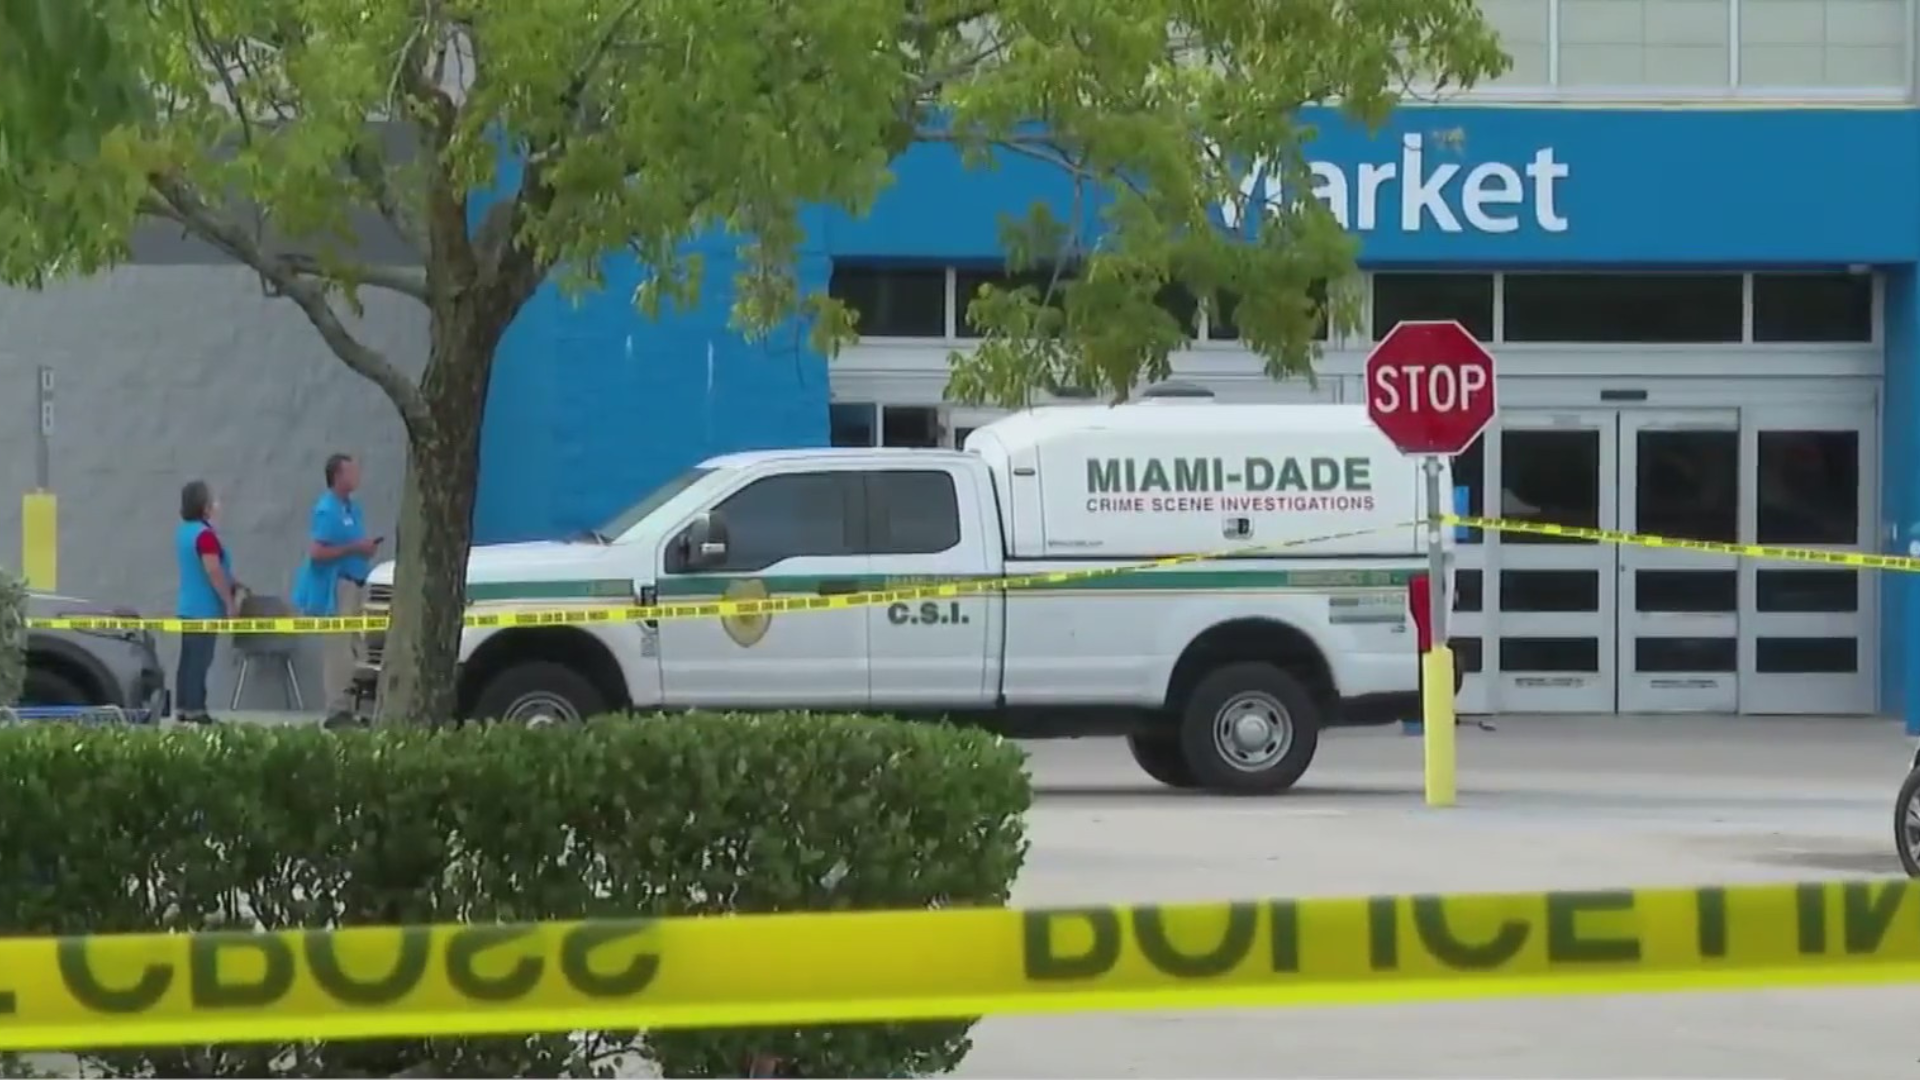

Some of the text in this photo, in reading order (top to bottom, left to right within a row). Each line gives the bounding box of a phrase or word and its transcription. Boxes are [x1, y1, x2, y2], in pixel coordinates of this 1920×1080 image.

[1375, 364, 1487, 412] STOP
[1086, 457, 1372, 493] MIAMI-DADE
[1086, 495, 1374, 512] CRIME SCENE INVESTIGATIONS
[888, 602, 970, 625] C.S.I.
